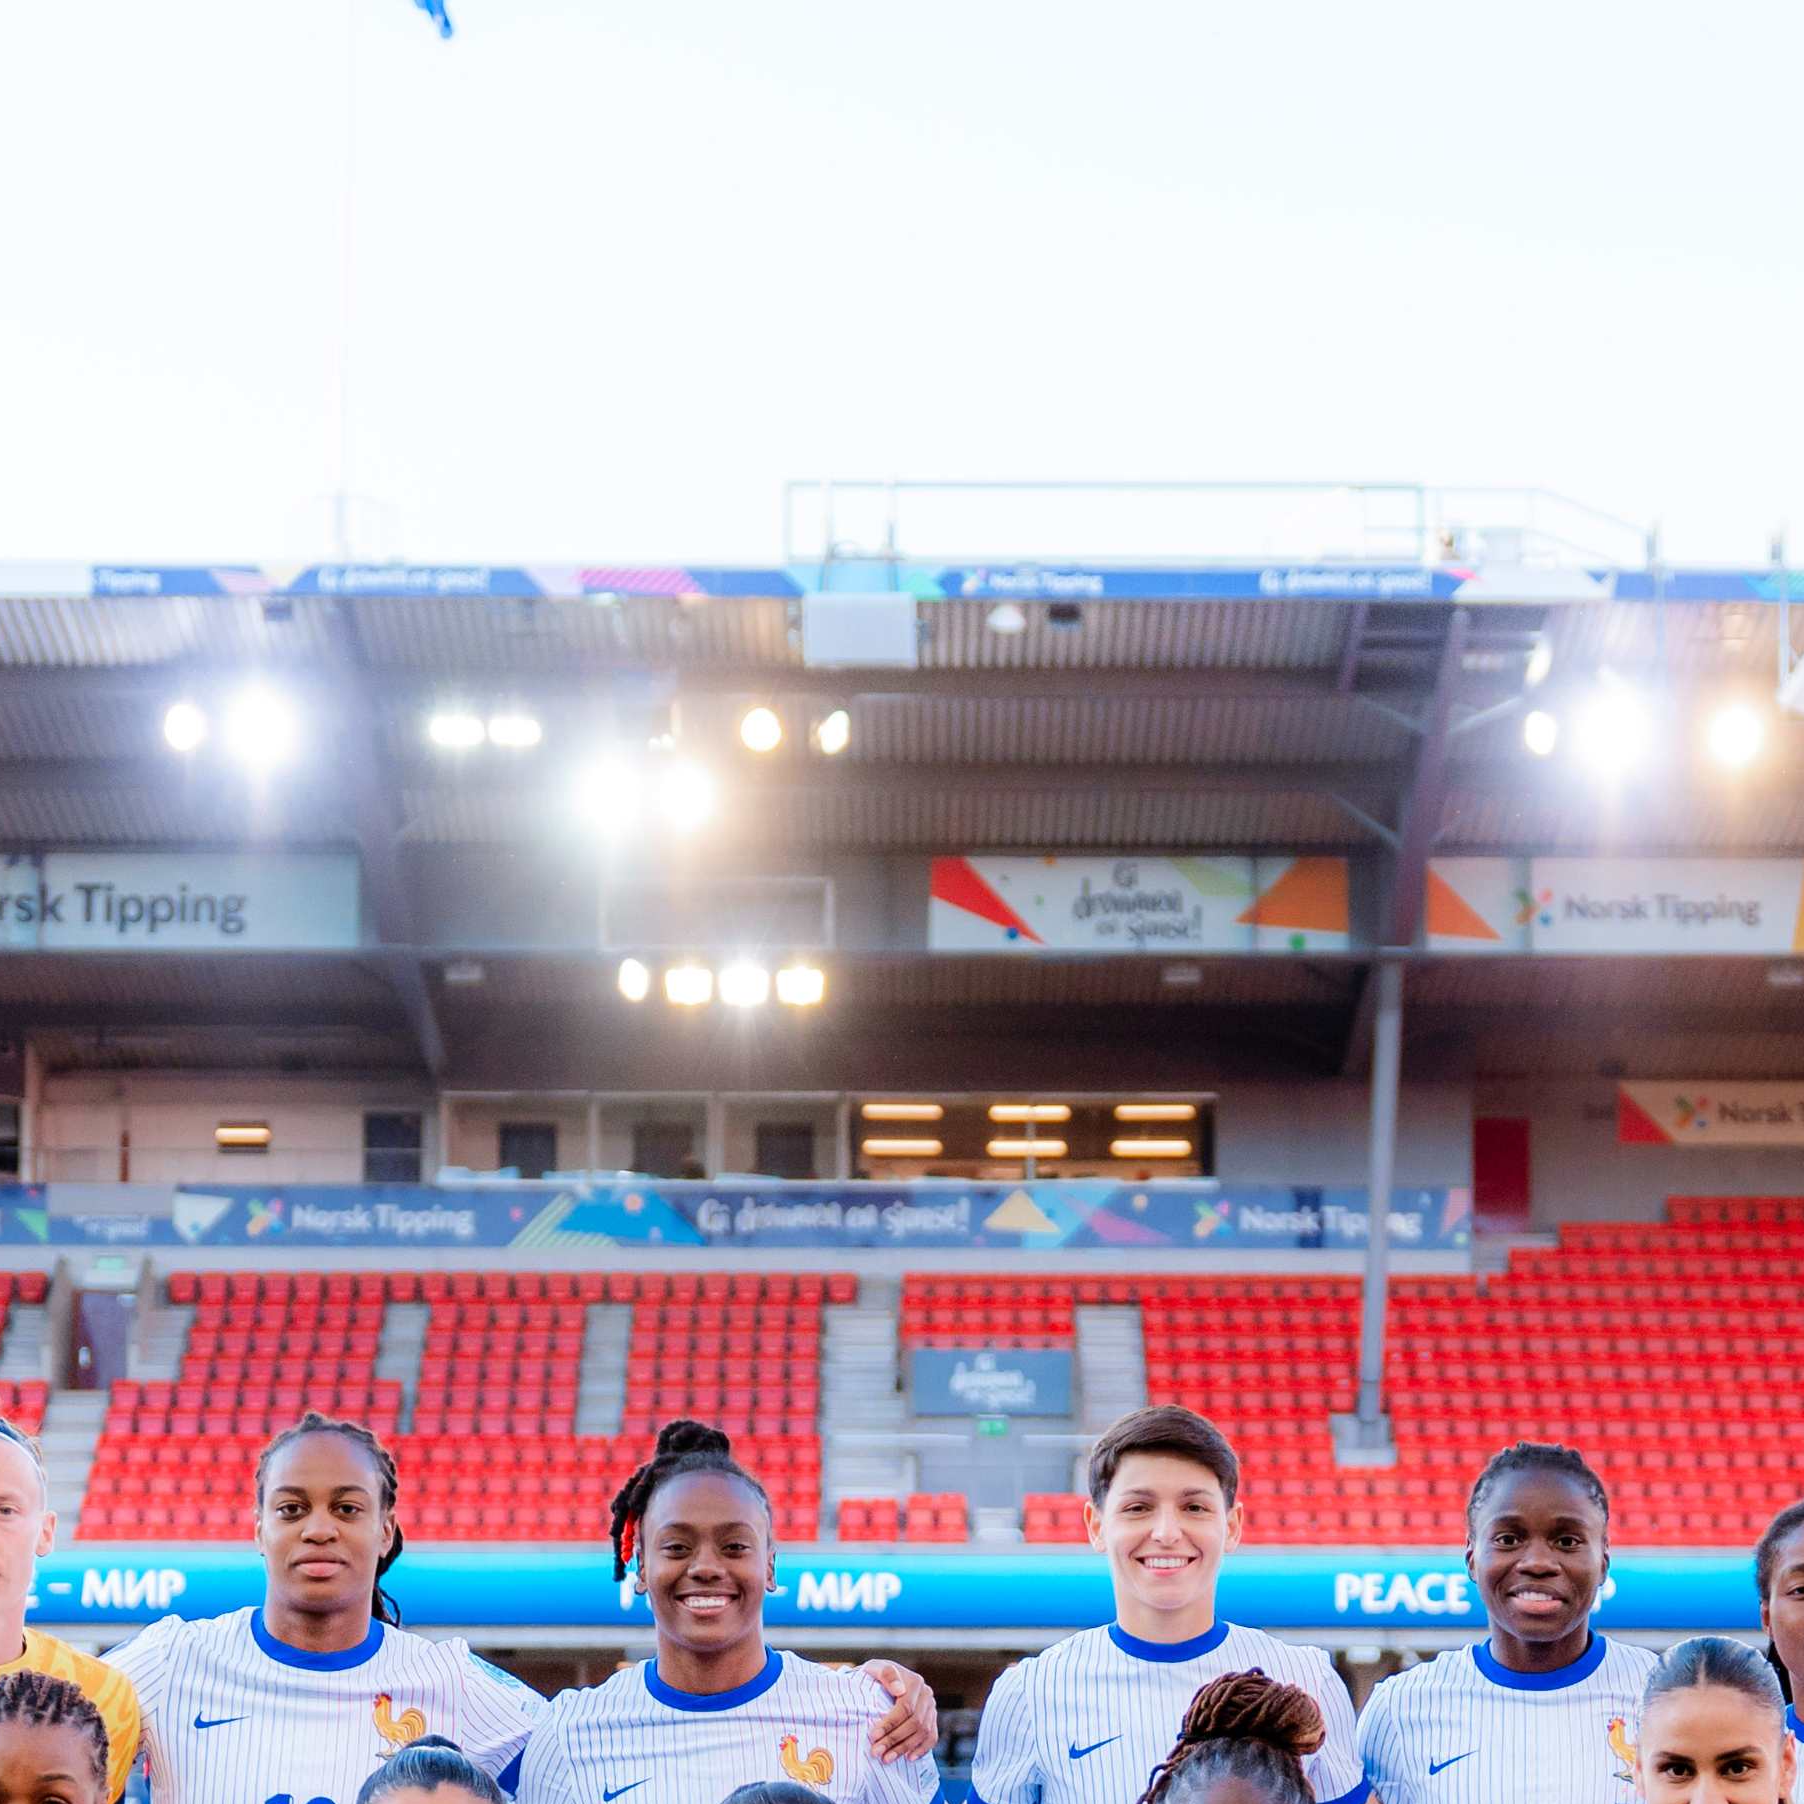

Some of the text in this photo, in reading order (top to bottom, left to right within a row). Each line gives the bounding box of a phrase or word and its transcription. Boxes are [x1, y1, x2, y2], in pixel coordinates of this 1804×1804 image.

[73, 882, 246, 936] Tipping
[1564, 894, 1761, 926] Norsk Tipping
[1718, 1102, 1794, 1125] Norsk
[292, 1205, 475, 1239] Norsk Tipping
[1240, 1207, 1318, 1232] Norsk
[81, 1569, 186, 1609] МИР
[796, 1571, 901, 1612] МИР
[1334, 1573, 1471, 1614] PEACE
